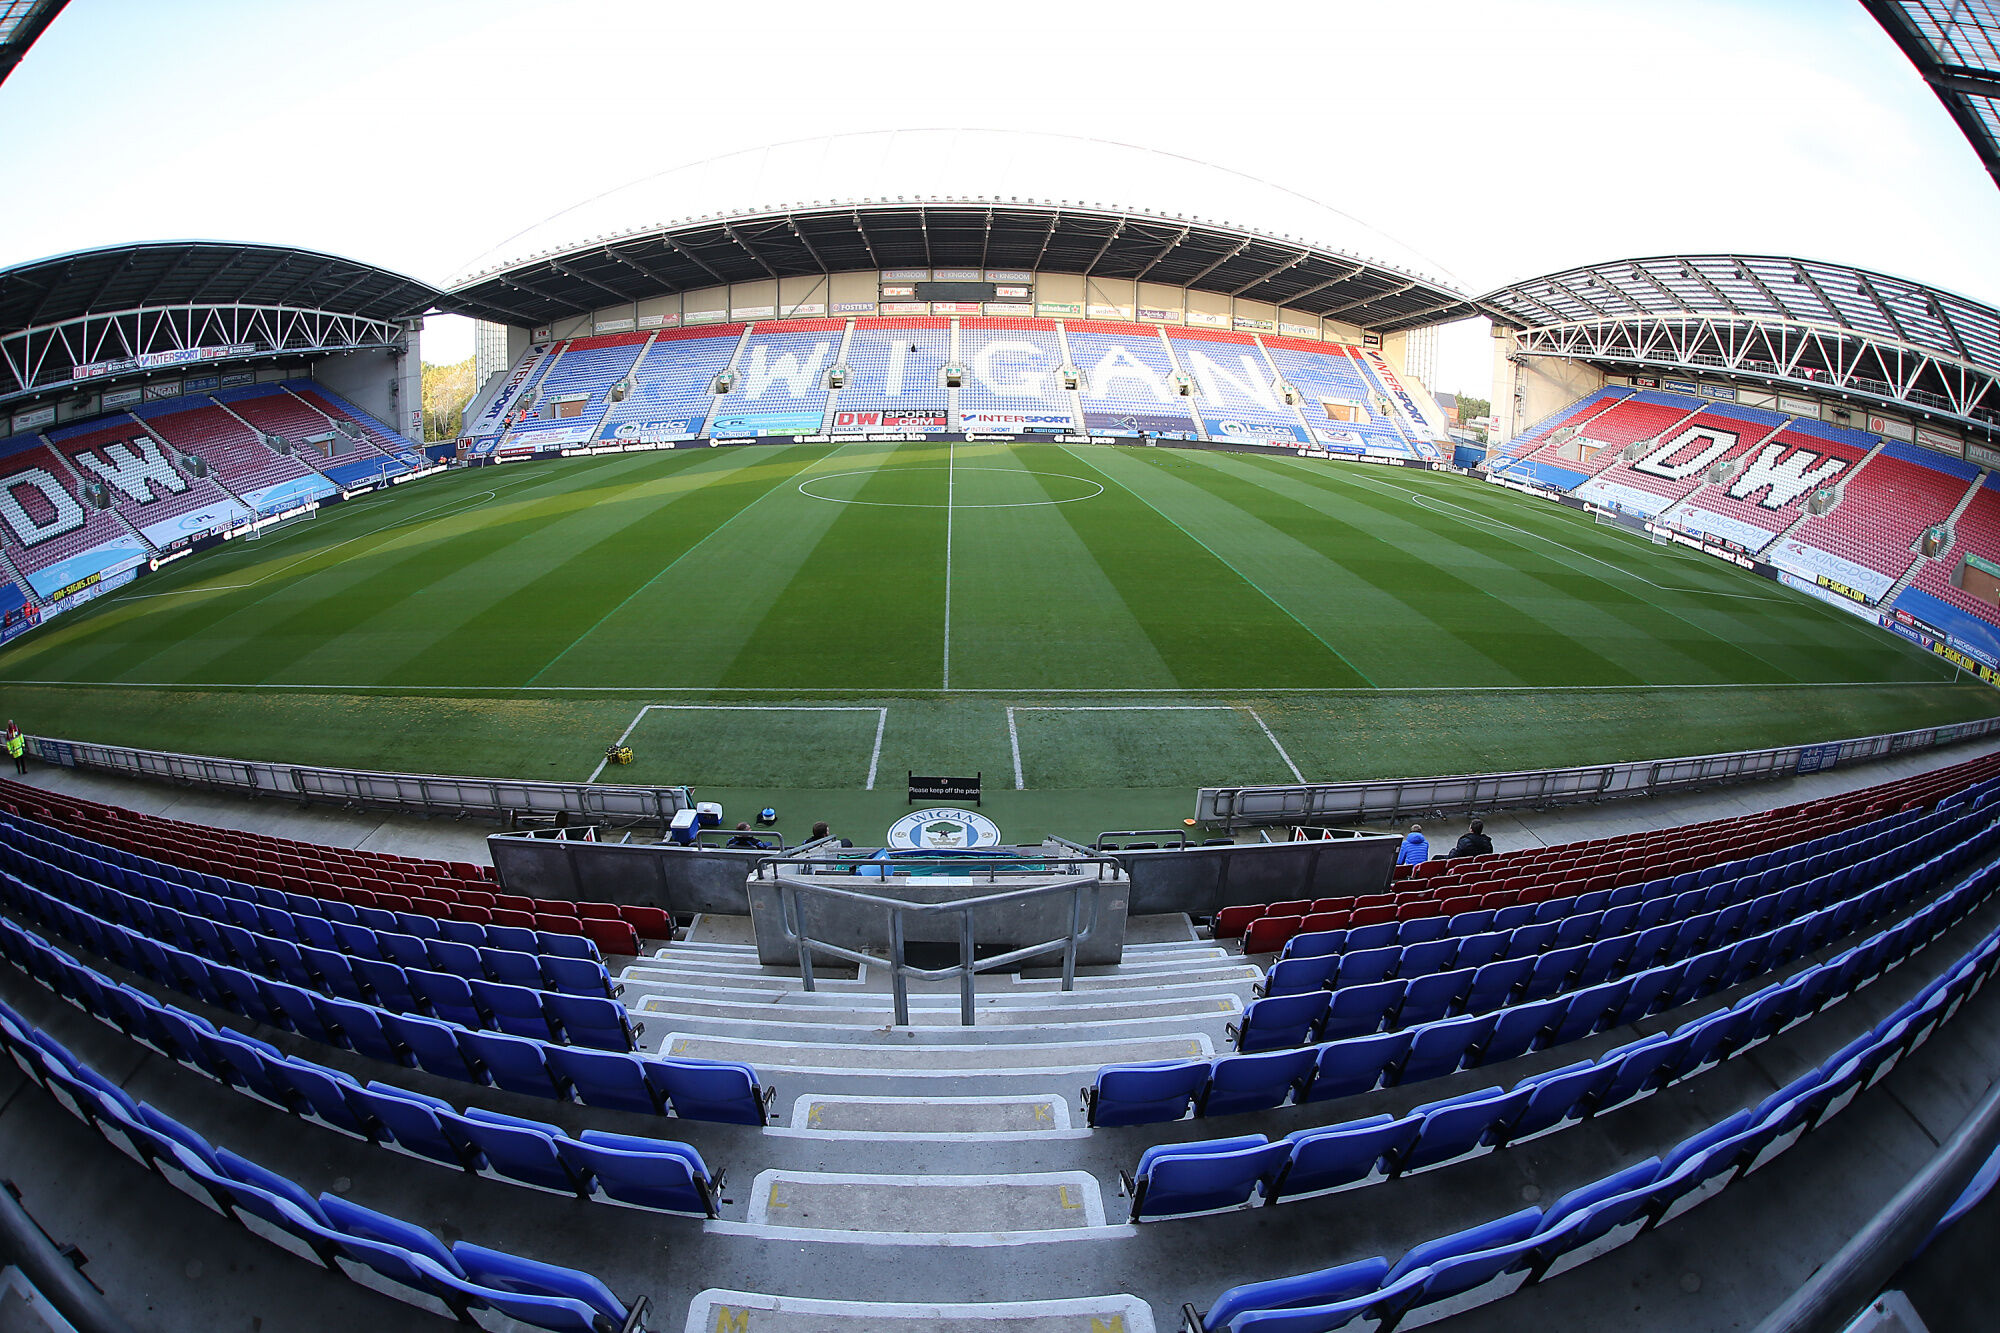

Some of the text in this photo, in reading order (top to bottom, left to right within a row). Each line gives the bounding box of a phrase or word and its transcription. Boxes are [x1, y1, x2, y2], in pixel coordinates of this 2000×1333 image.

[897, 271, 927, 279] KINGDOM
[948, 271, 979, 279] KINGDOM
[1000, 272, 1030, 280] KINGDOM
[841, 303, 873, 311] FOSTER'S
[150, 349, 199, 366] INTERSPORT
[201, 347, 213, 358] DW
[74, 367, 88, 380] DW
[485, 354, 541, 419] INTERSPORT
[1372, 360, 1429, 426] INTERSPORT
[838, 413, 880, 425] DW
[884, 410, 945, 418] SPORTS
[895, 418, 935, 426] .COM
[979, 414, 1072, 424] INTERSPORT
[641, 420, 688, 431] Latics
[1246, 423, 1292, 436] Latics
[458, 437, 473, 450] DW
[868, 433, 905, 442] contract
[217, 515, 249, 533] INTERSPORT
[1670, 521, 1703, 538] INTERSPORT
[1702, 512, 1770, 544] KINGDOM
[1703, 543, 1738, 563] contract
[1737, 553, 1755, 570] hire
[105, 567, 138, 591] KINGDOM
[1812, 552, 1889, 589] KINGDOM
[53, 572, 100, 601] DM-SIGNS.COM
[1793, 578, 1828, 600] KINGDOM
[1818, 574, 1865, 603] DM-SIGNS.COM
[55, 595, 75, 613] PUMP
[1933, 641, 1975, 673] DM-SIGNS.COM
[909, 786, 928, 794] Please
[930, 786, 943, 795] keep
[945, 786, 953, 794] off
[965, 788, 980, 796] pitch
[909, 810, 980, 824] WIGAN
[673, 1039, 688, 1053] J
[808, 1105, 823, 1123] K
[1034, 1103, 1052, 1122] K
[768, 1183, 789, 1209] L
[1058, 1185, 1081, 1210] L
[716, 1305, 748, 1333] M
[1090, 1315, 1124, 1333] M
